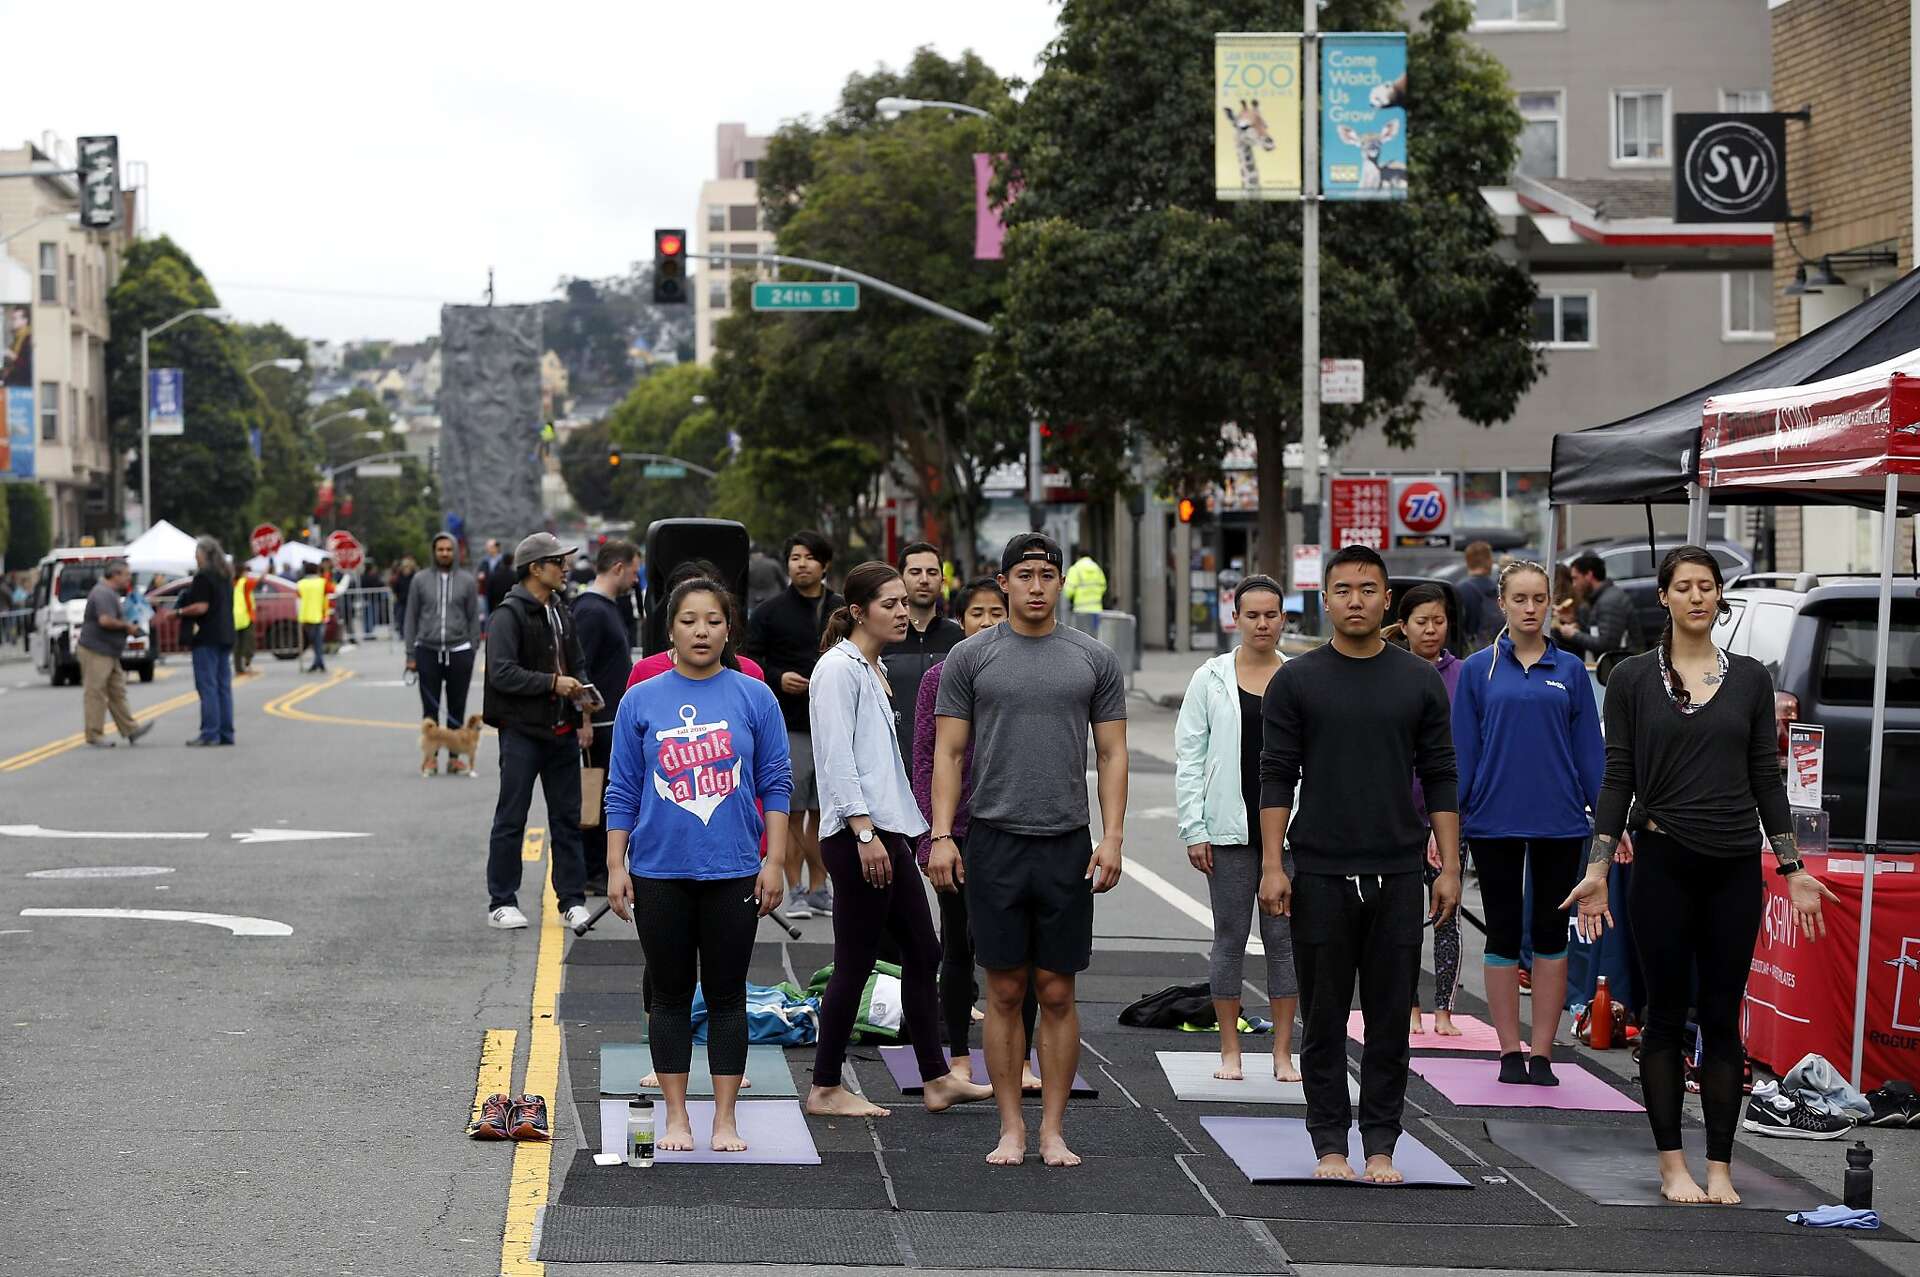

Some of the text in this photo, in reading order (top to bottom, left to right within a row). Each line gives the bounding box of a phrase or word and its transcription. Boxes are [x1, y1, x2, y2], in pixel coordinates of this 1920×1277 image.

[1328, 51, 1376, 67] Come
[1223, 64, 1294, 88] ZOO
[1328, 69, 1381, 85] Watch
[1328, 88, 1349, 104] Us
[1328, 106, 1376, 122] Grow
[1704, 145, 1759, 193] SV
[771, 288, 841, 304] 24th St
[1406, 491, 1441, 521] 76
[1341, 528, 1382, 539] FOOD
[663, 733, 732, 771] dunk
[675, 780, 690, 799] a
